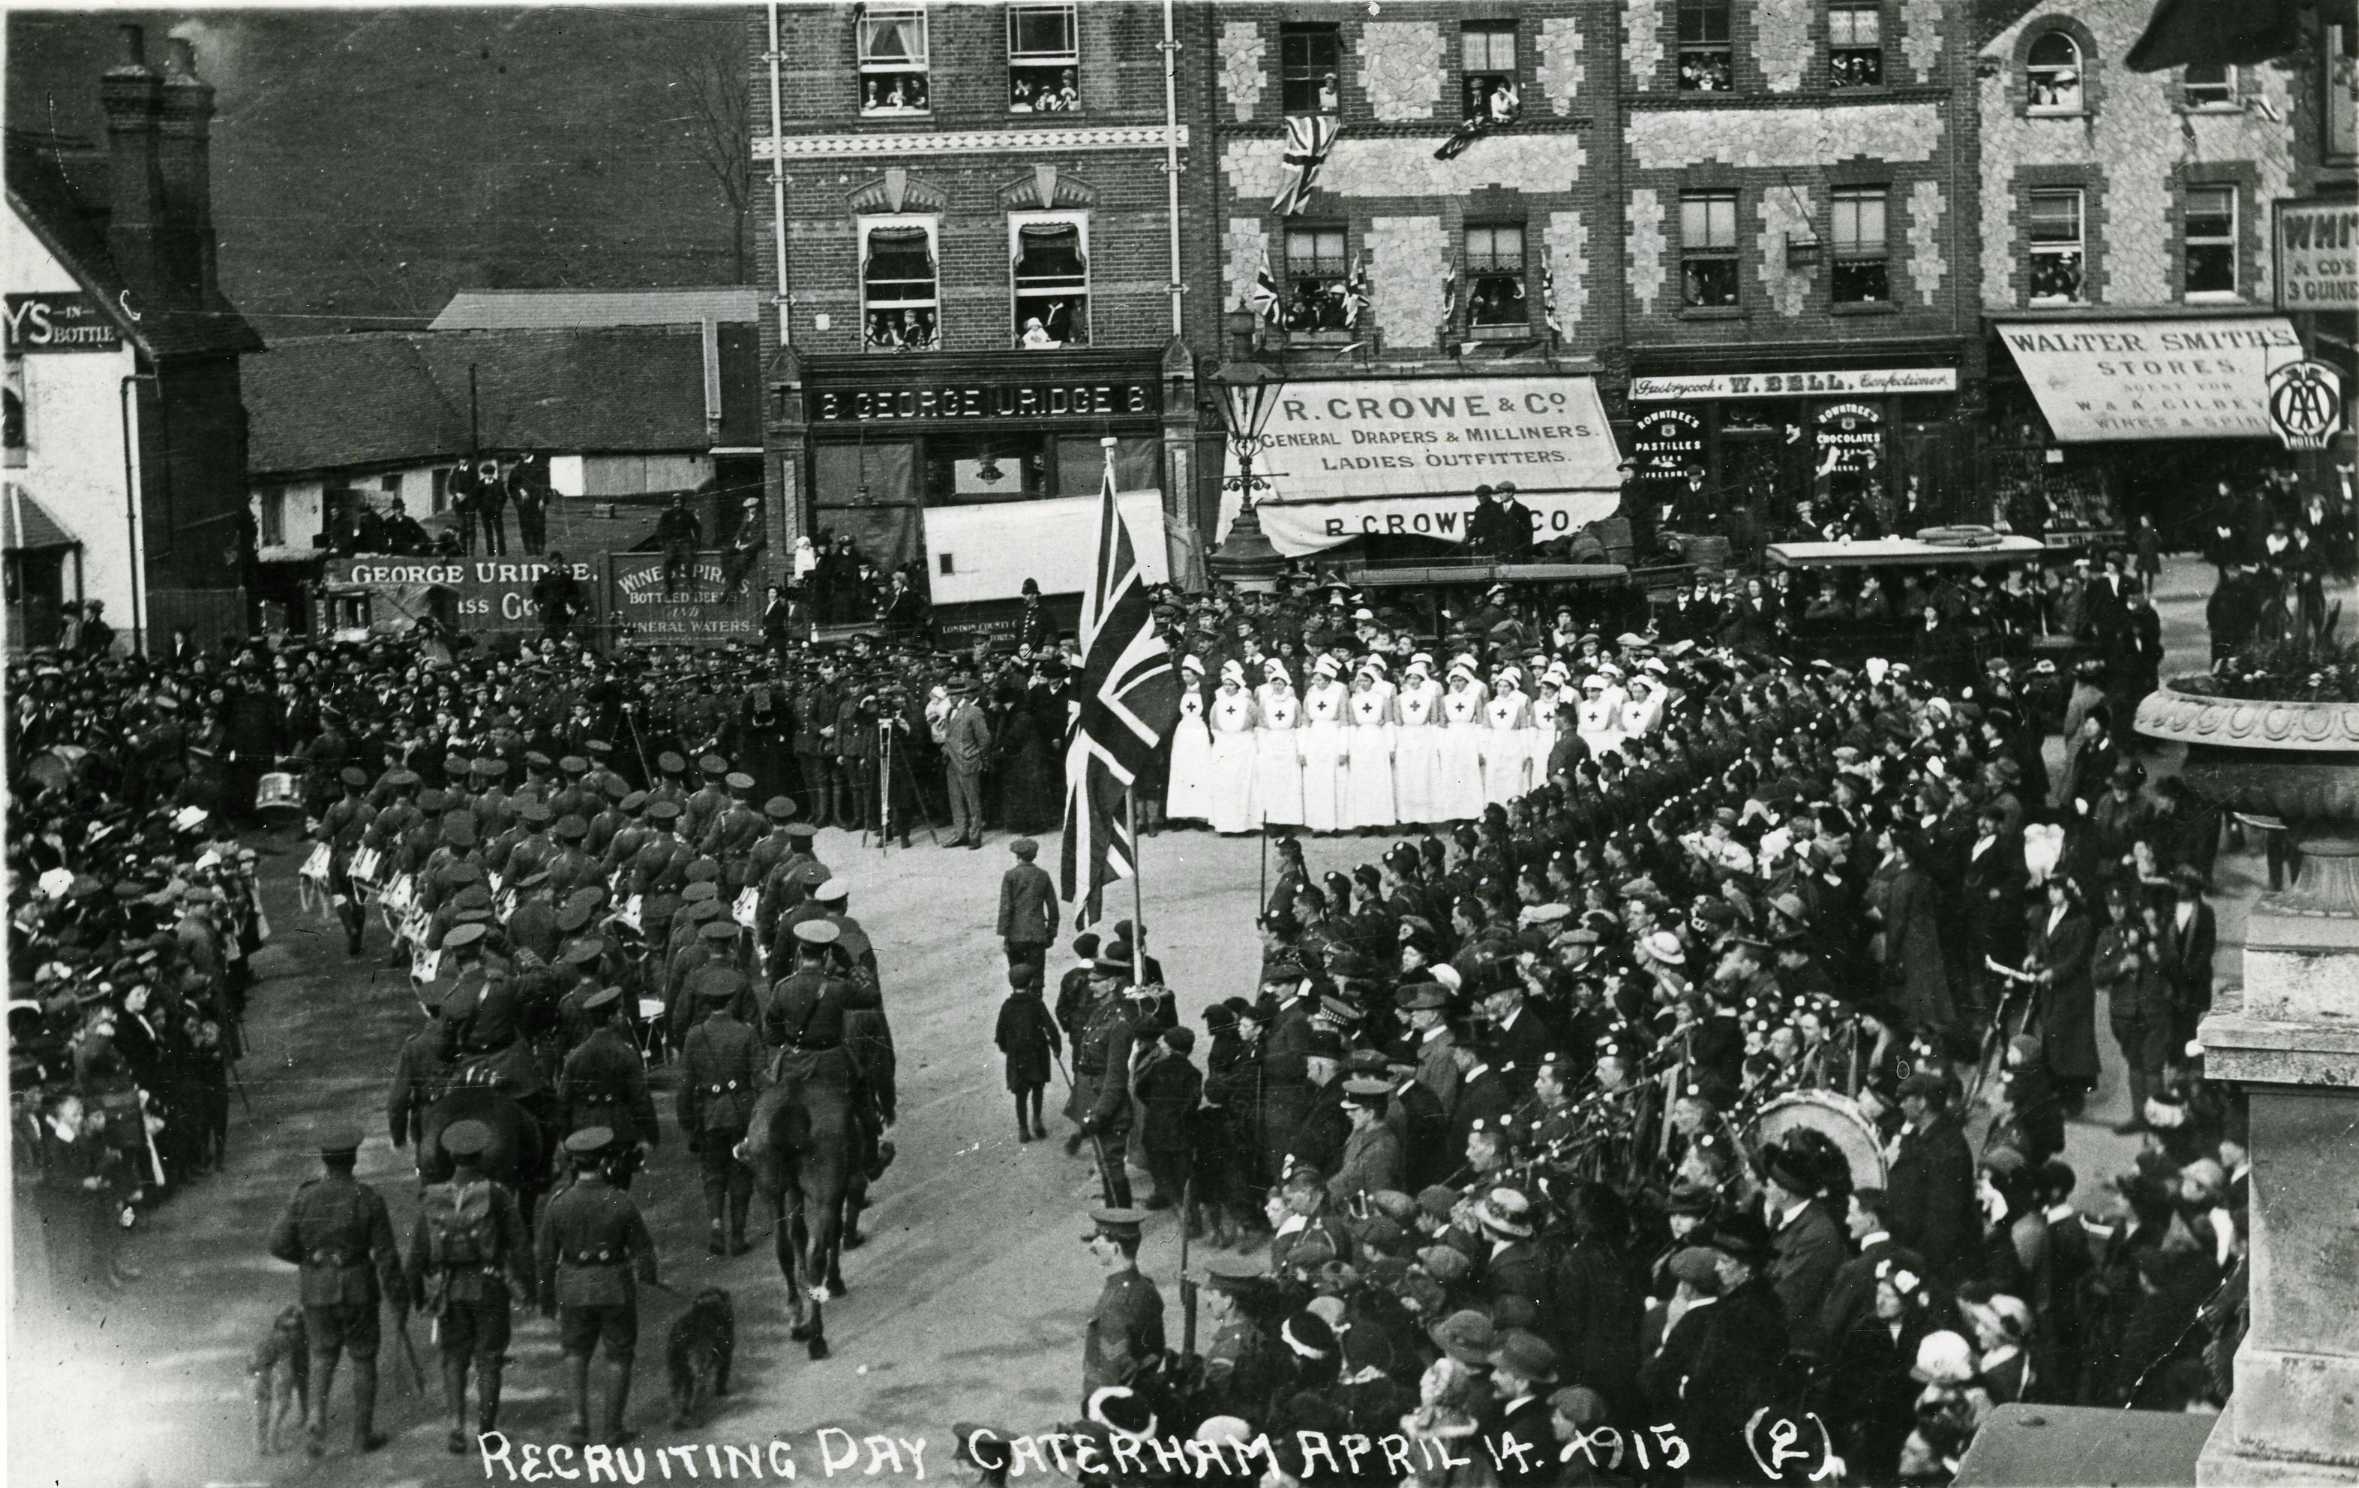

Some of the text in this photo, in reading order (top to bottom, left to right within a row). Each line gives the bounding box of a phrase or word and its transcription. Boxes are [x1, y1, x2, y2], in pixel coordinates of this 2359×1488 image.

[53, 326, 115, 343] BOTTLE
[2009, 326, 2300, 353] WALTER SMITH'S
[1729, 376, 1759, 394] W.
[855, 389, 981, 418] GEORGE
[997, 386, 1113, 416] URIDGE
[1282, 398, 1321, 422] R.
[1327, 395, 1492, 420] CROWE
[1498, 396, 1517, 413] &
[2075, 399, 2092, 411] W
[2131, 399, 2145, 411] A
[2160, 398, 2265, 412] GILBEY
[1637, 409, 1700, 430] ROWNTREE'S
[1260, 424, 1600, 449] GENERAL DRAPERS & MILLINERS.
[1635, 440, 1701, 452] PASTILLES
[1816, 432, 1881, 444] CHOCOLATES
[1321, 450, 1572, 472] LADIES OUTFITTERS.
[351, 564, 465, 585] GEORGE
[690, 619, 751, 633] WATERS
